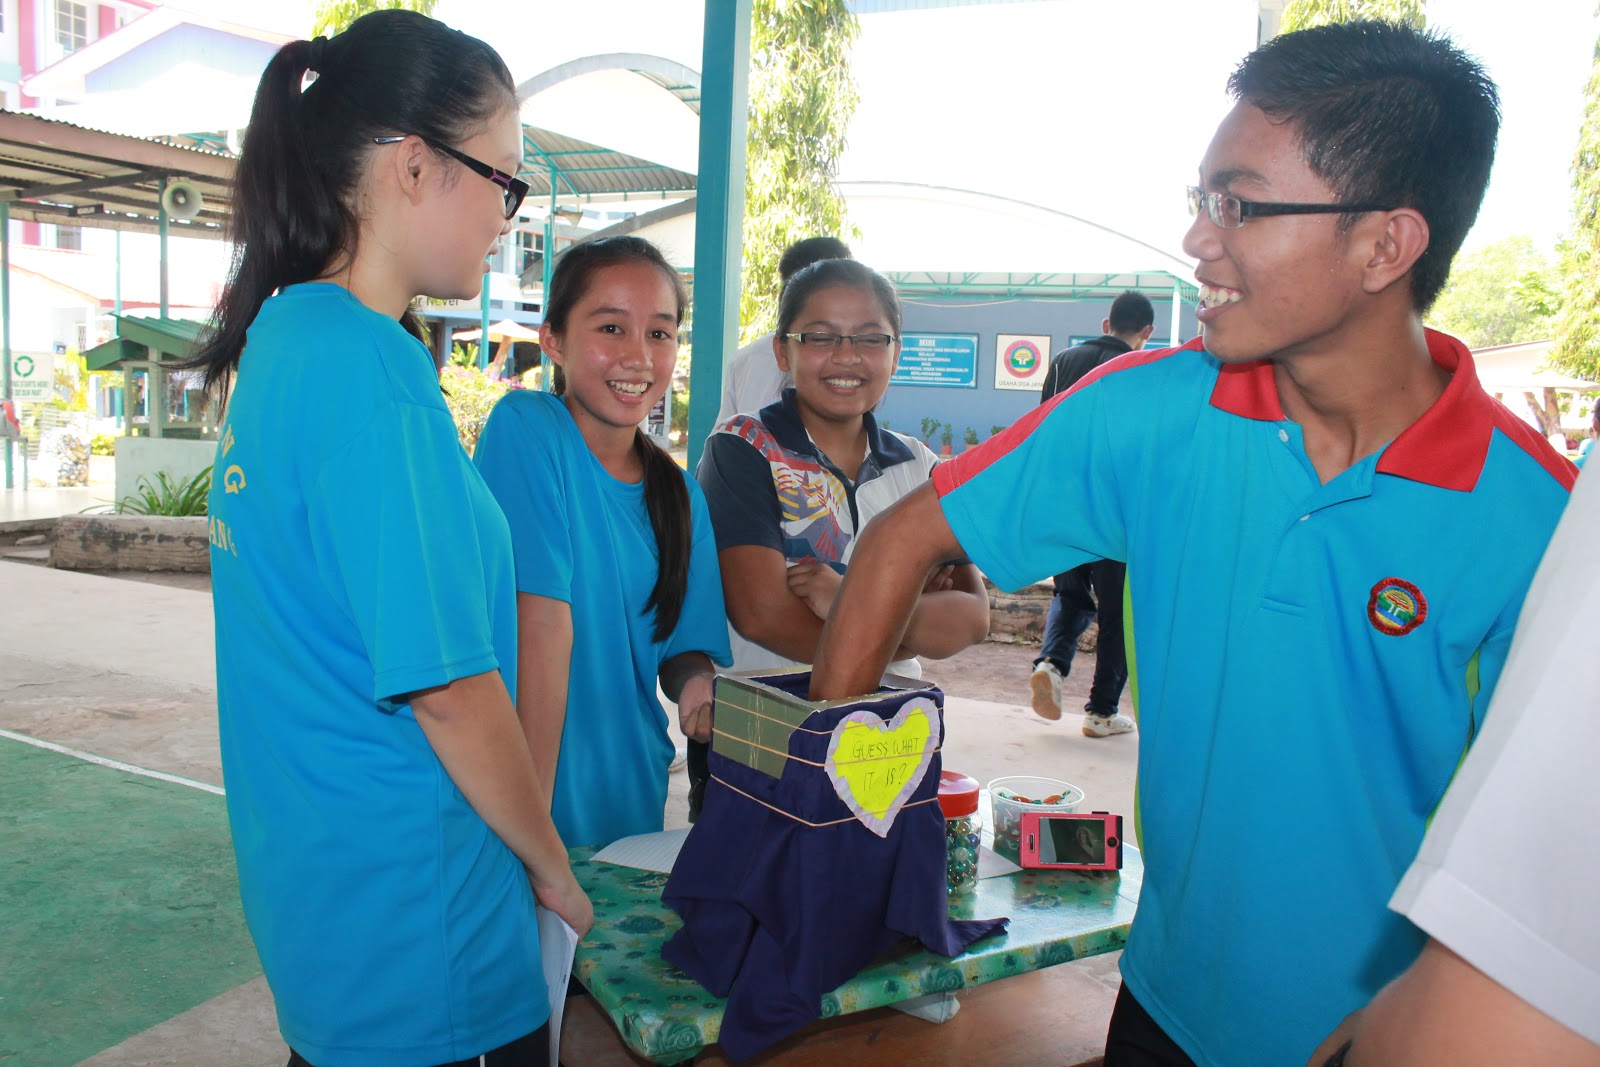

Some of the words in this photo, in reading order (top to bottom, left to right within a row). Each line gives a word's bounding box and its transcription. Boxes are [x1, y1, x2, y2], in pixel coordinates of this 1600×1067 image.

[919, 339, 936, 347] MISI
[852, 740, 889, 761] GUESS
[893, 737, 920, 755] WHAT
[863, 771, 875, 792] IT
[885, 762, 907, 787] IS?
